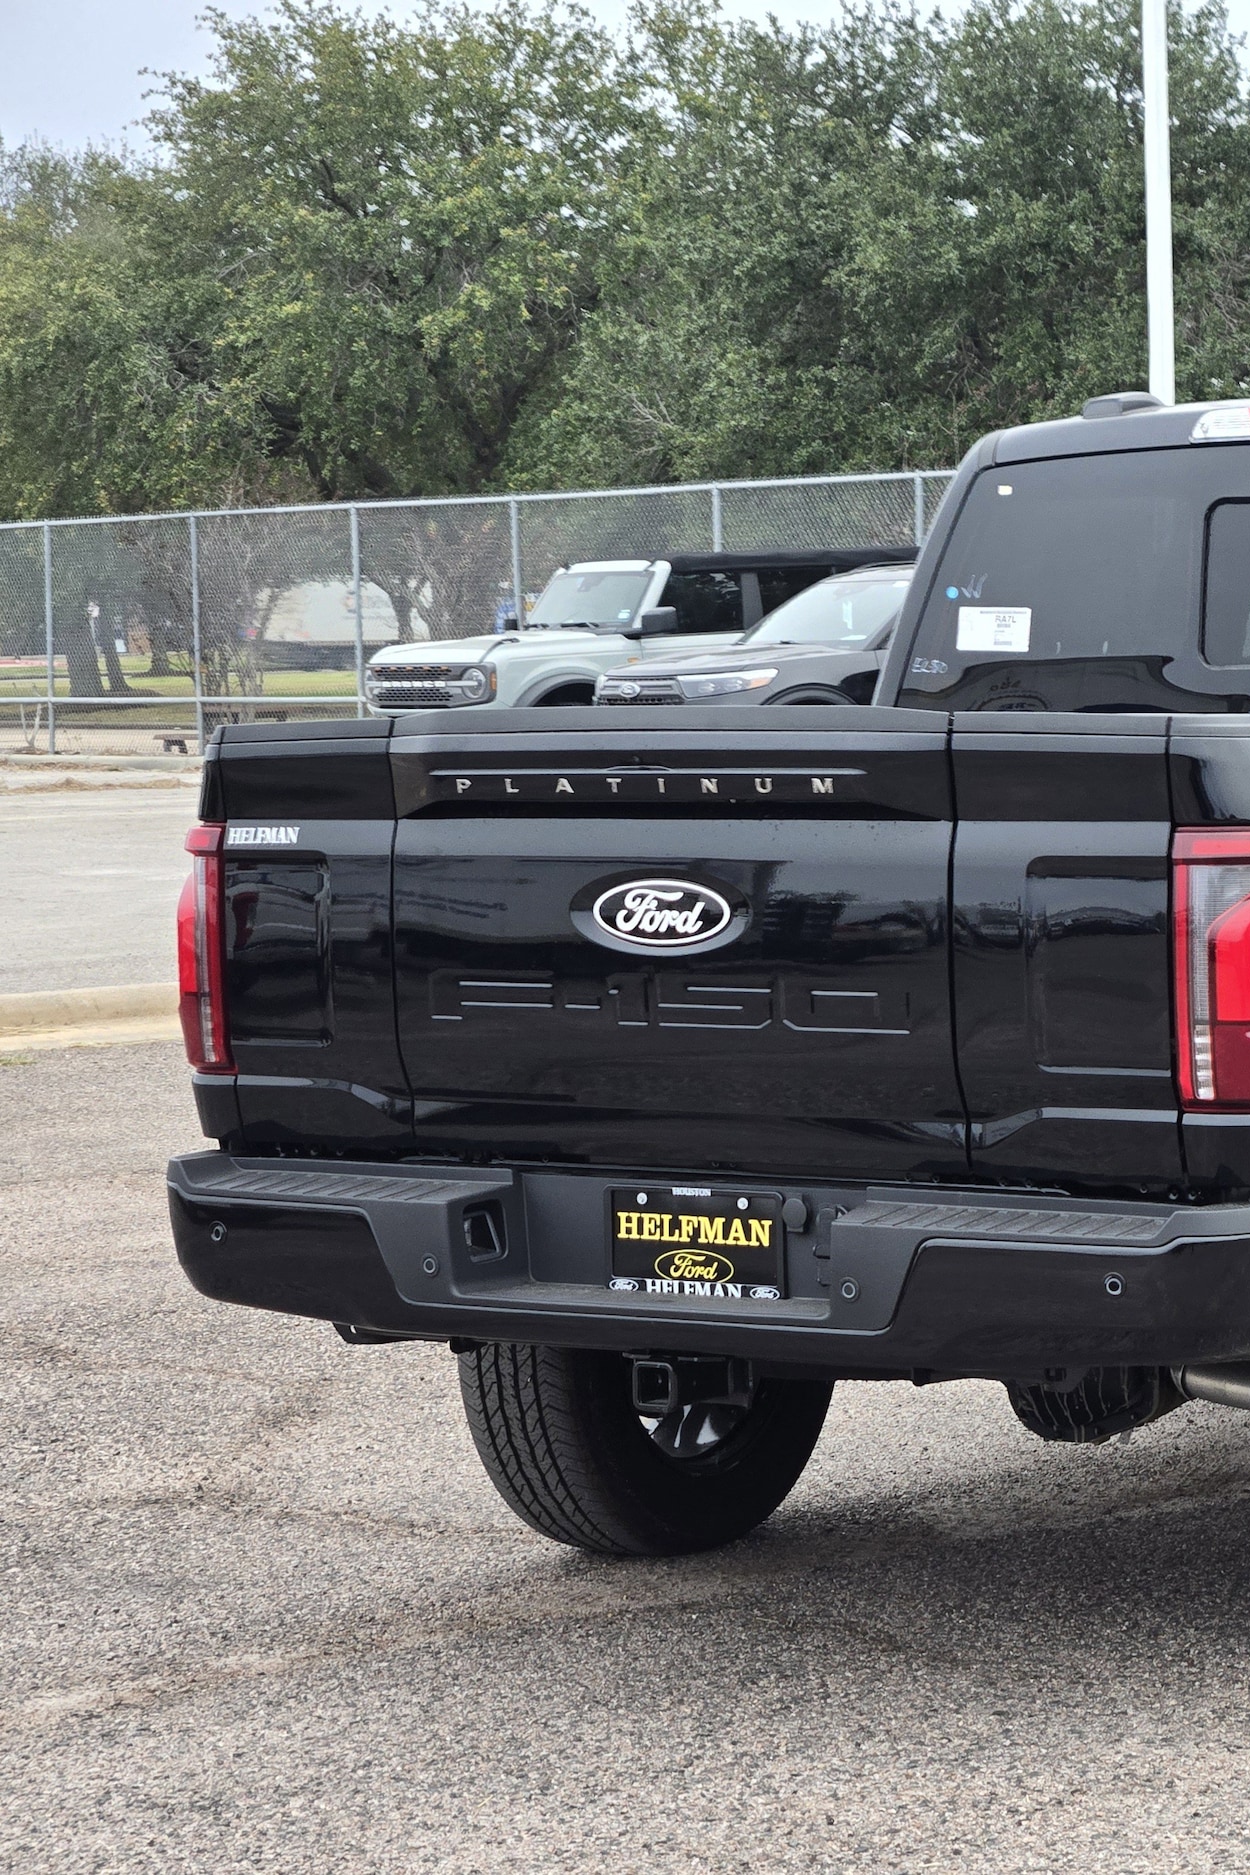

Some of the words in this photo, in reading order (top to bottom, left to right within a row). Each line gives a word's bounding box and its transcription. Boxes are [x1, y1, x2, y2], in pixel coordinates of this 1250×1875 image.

[456, 777, 835, 795] PLATINUM
[227, 827, 300, 844] HELFMAN
[615, 888, 705, 933] Ford
[617, 1212, 772, 1247] HELFMAN
[670, 1253, 718, 1279] Ford
[645, 1279, 742, 1298] HELFMAN
